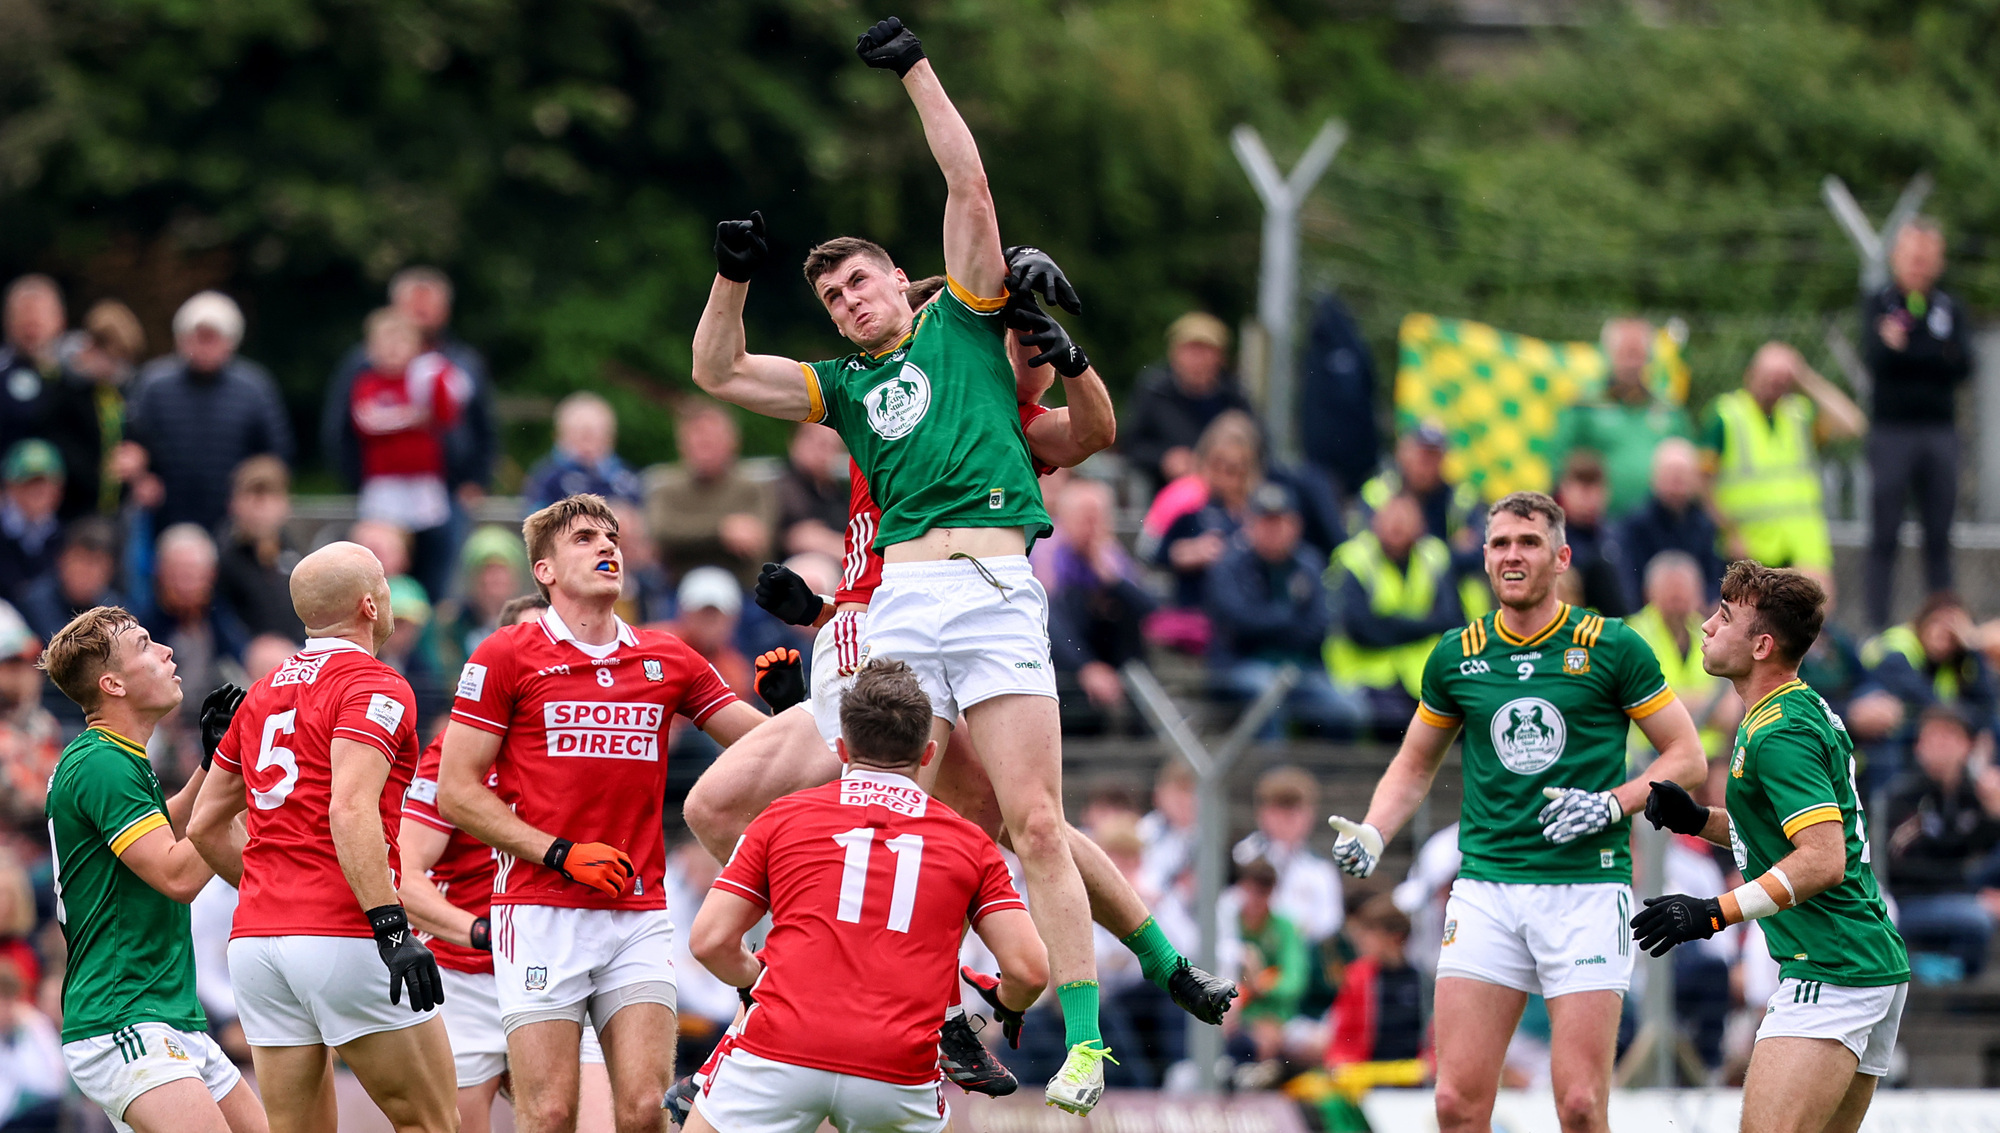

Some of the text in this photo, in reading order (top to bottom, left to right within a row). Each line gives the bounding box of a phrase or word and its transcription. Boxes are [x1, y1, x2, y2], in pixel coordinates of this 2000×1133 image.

[1510, 651, 1542, 662] oneills
[596, 667, 615, 688] 8
[1517, 662, 1535, 681] 9
[554, 704, 659, 727] SPORTS
[556, 733, 653, 757] DIRECT
[250, 708, 299, 810] 5
[847, 793, 919, 815] DIRECT
[848, 781, 922, 805] SPORTS
[831, 827, 924, 934] 11
[1574, 955, 1607, 966] oneills
